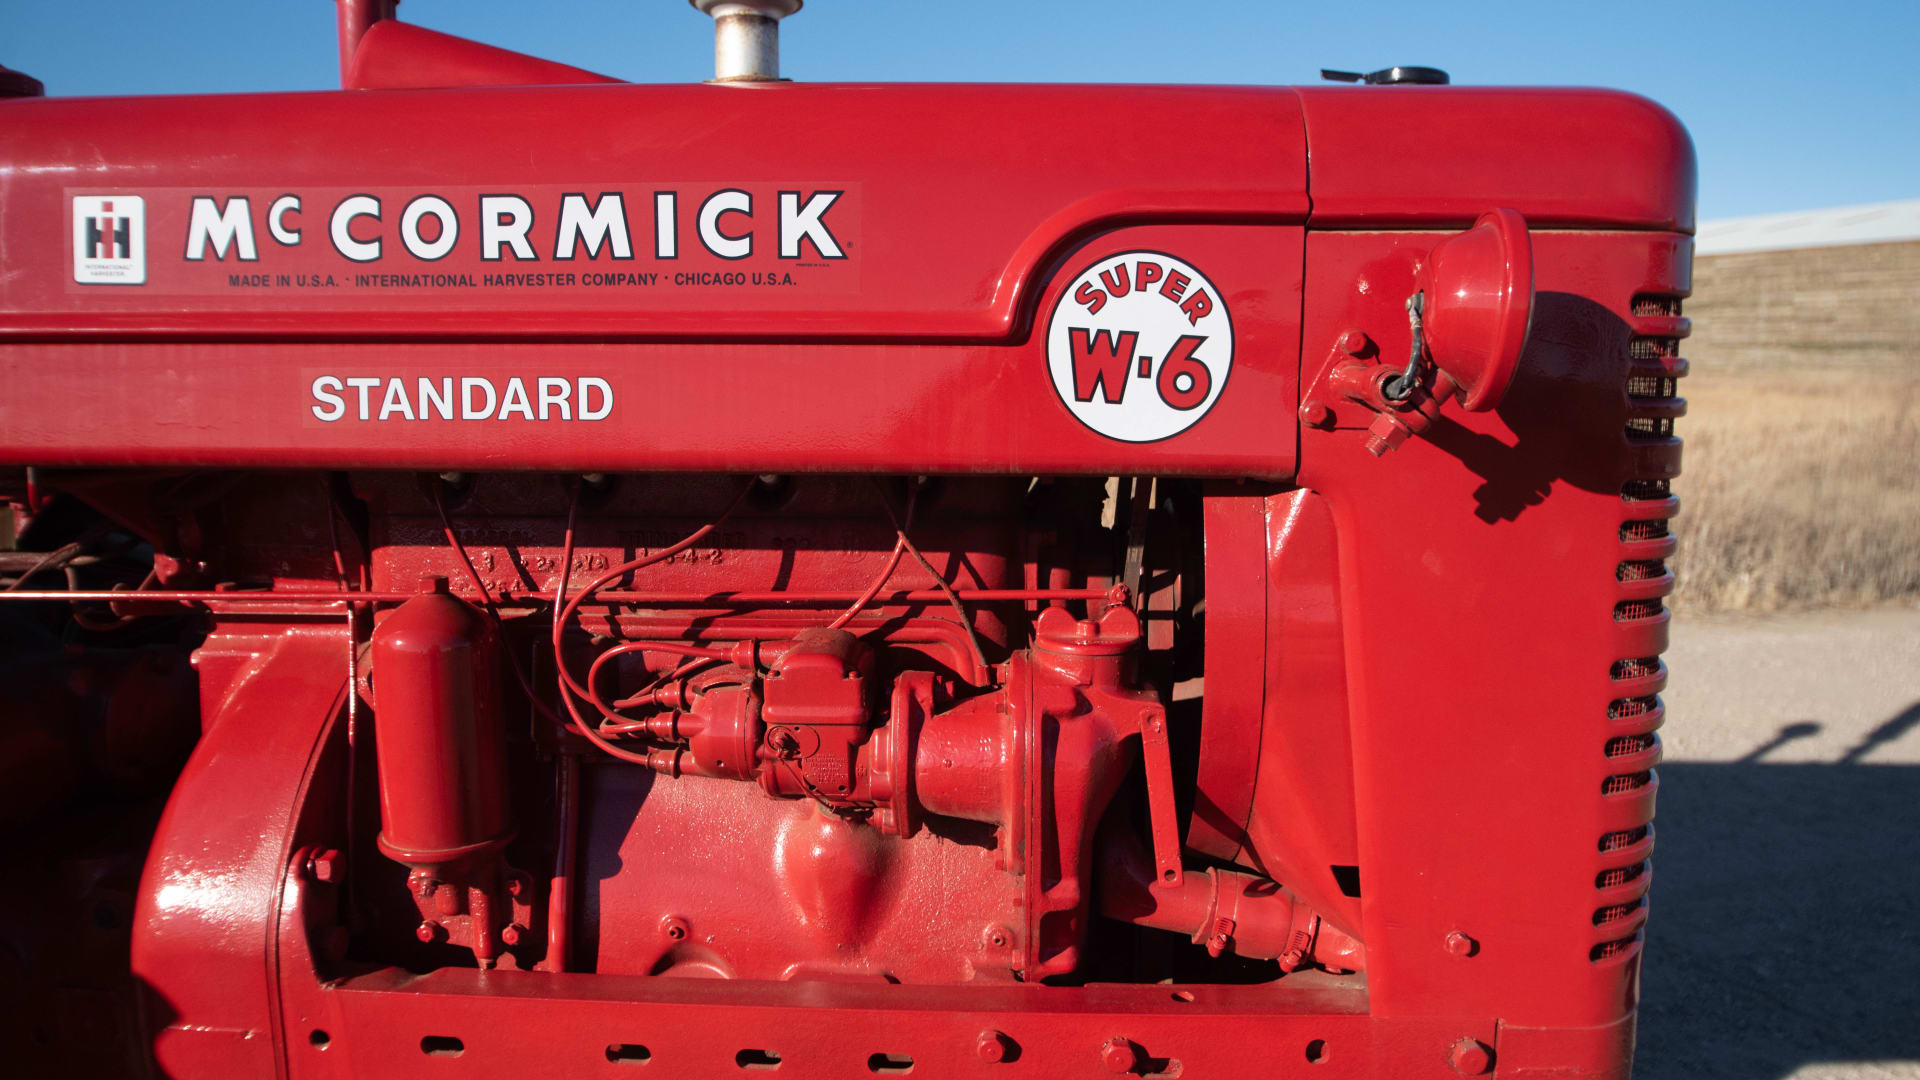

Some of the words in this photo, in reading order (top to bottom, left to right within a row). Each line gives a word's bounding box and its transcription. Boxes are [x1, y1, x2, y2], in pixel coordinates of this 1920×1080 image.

[228, 274, 271, 288] MADE
[276, 274, 291, 287] IN
[296, 274, 339, 288] U.S.A.
[355, 274, 477, 288] INTERNATIONAL
[483, 273, 576, 287] HARVESTER
[582, 273, 658, 287] COMPANY
[674, 272, 746, 287] CHICAGO
[751, 272, 798, 287] U.S.A.
[1074, 261, 1213, 327] SUPER
[1068, 326, 1213, 412] W-6
[310, 375, 615, 422] STANDARD
